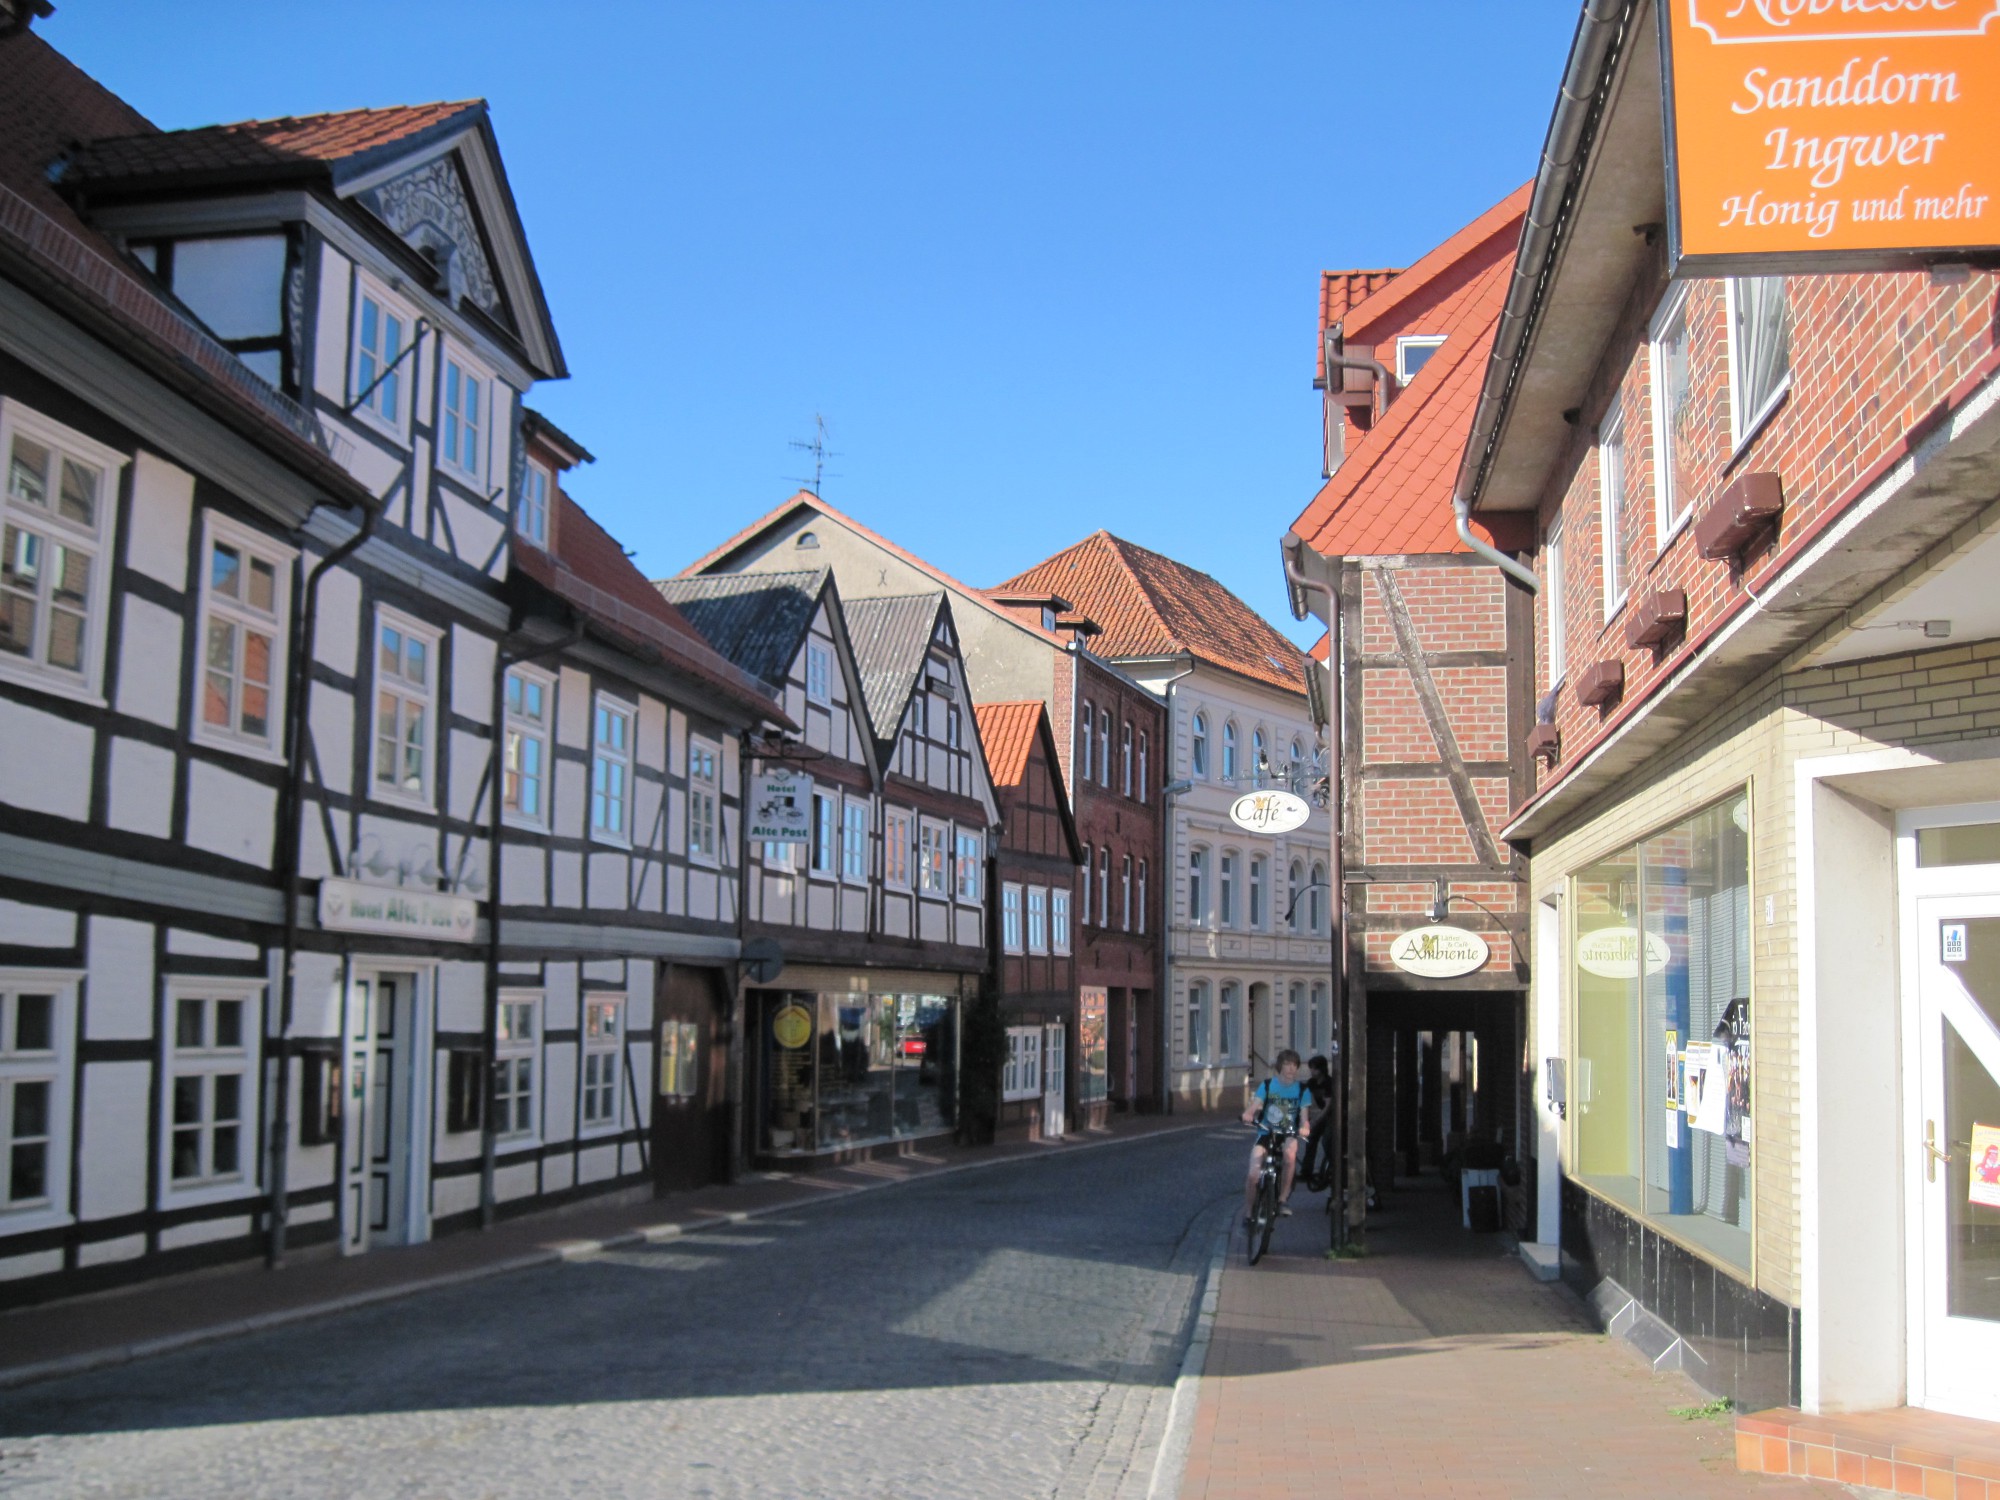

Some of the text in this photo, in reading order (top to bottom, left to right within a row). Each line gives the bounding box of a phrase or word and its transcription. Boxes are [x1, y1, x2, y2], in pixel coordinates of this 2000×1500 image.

[1731, 56, 1960, 115] Sanddorn
[1764, 127, 1944, 189] Ingwer
[1718, 183, 1989, 238] Honig und mehr
[767, 784, 797, 793] Hotel
[1235, 794, 1281, 828] Café
[752, 826, 808, 837] Alte Post
[1399, 934, 1479, 961] Ambiente
